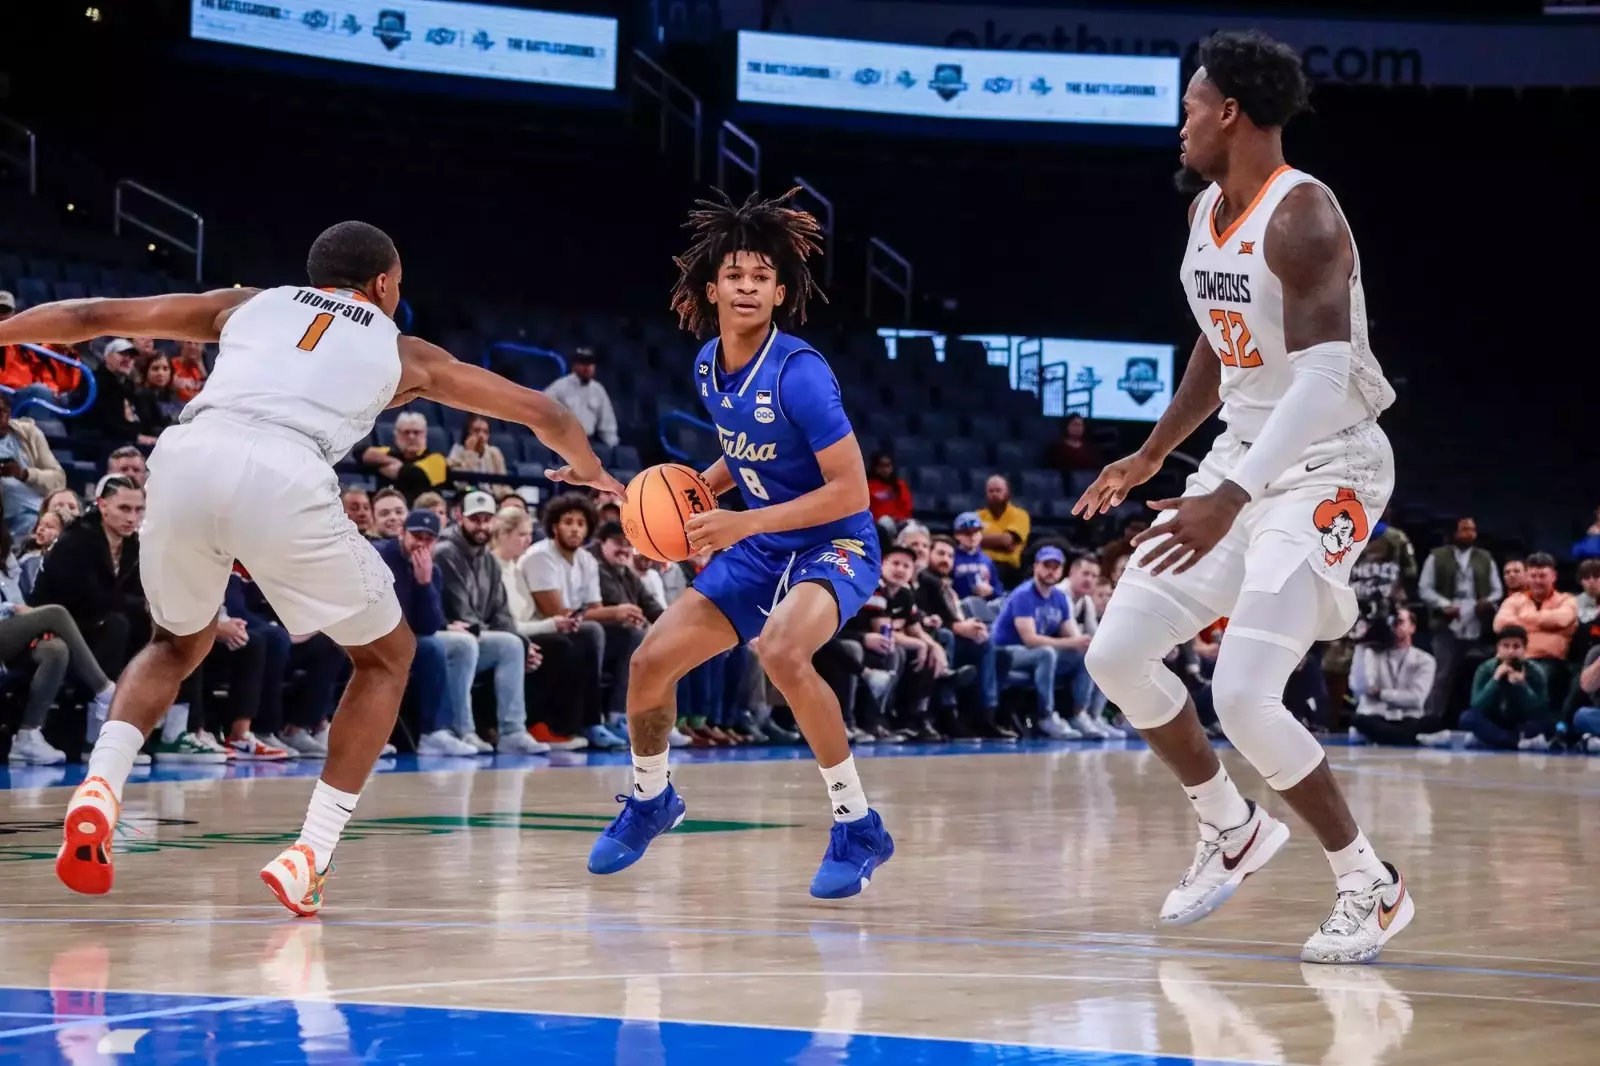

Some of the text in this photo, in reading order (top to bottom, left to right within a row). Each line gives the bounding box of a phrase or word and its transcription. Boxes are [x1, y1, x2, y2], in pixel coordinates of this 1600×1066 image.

[1194, 269, 1251, 303] COWBOYS
[292, 289, 375, 328] THOMPSON
[296, 312, 335, 352] 1
[1209, 308, 1264, 369] 32
[698, 364, 709, 375] 32
[715, 423, 777, 462] Tulsa
[738, 467, 770, 501] 8
